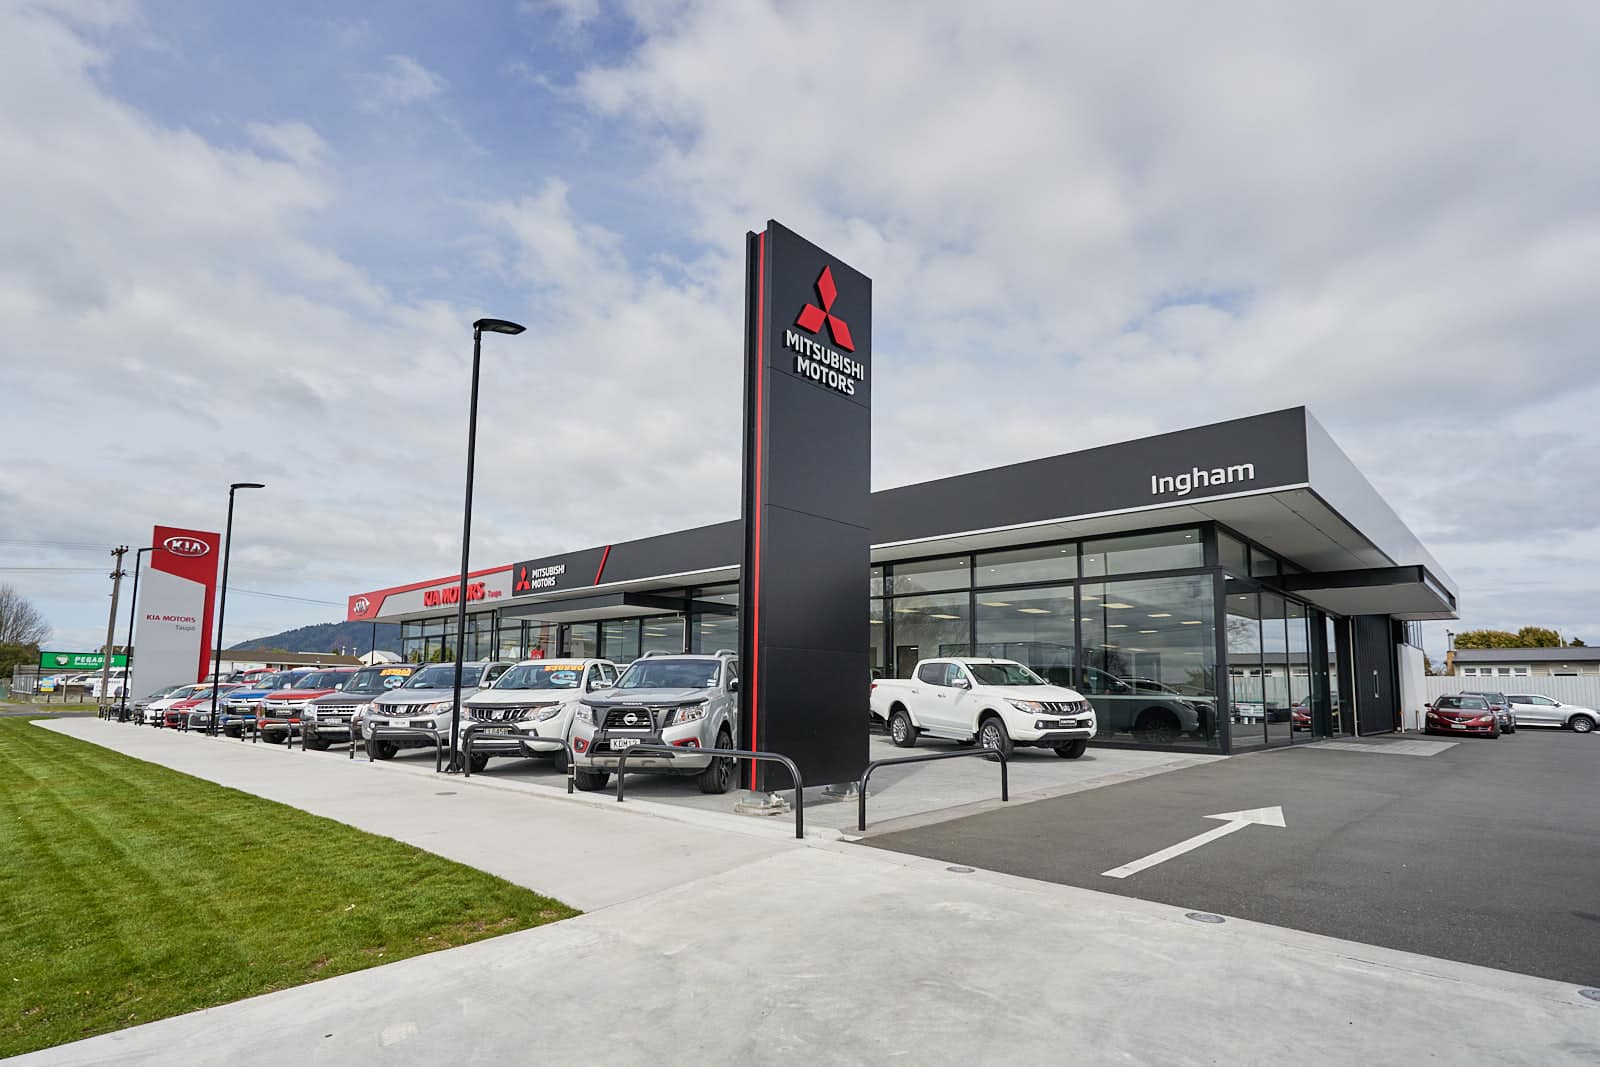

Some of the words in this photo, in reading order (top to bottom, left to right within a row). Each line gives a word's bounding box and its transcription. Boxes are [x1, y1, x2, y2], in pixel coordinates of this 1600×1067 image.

[786, 328, 864, 381] MITSUBISHI
[797, 355, 855, 395] MOTORS
[1151, 463, 1255, 496] Ingham
[171, 540, 203, 553] KIA
[532, 564, 565, 578] MITSUBISHI
[531, 576, 556, 589] MOTORS
[424, 590, 441, 607] KIA
[162, 615, 196, 623] MOTORS
[74, 654, 115, 664] PEGASS
